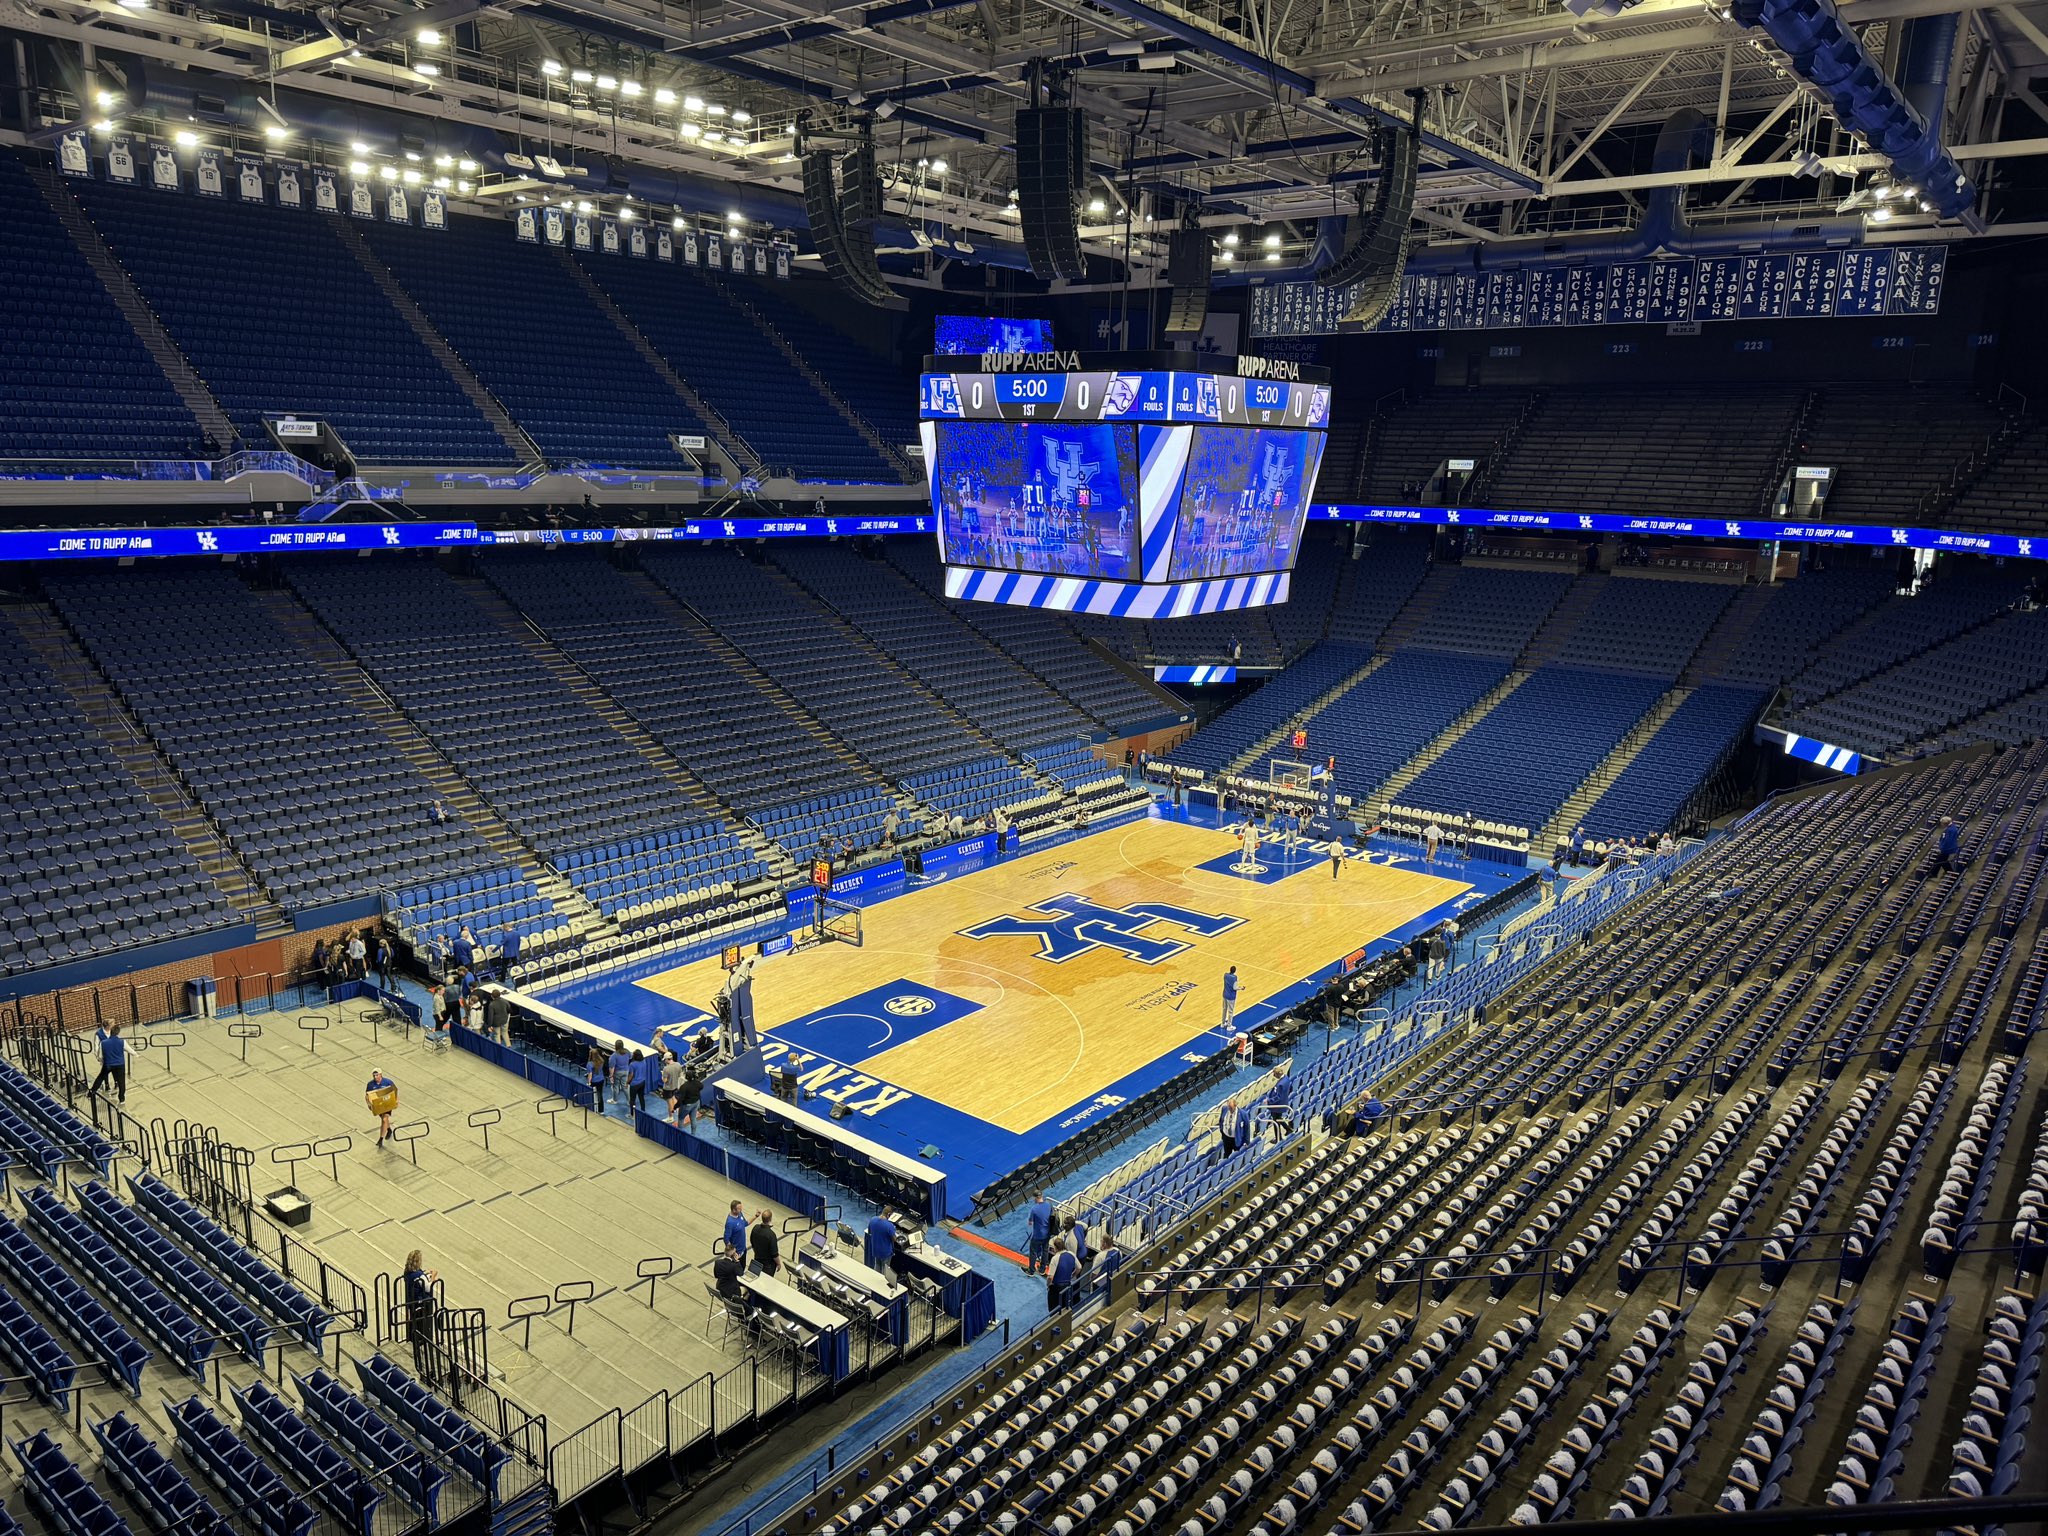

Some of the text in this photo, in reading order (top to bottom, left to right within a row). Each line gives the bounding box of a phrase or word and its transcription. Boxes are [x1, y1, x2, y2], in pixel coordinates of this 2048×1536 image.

[286, 184, 292, 192] 4
[314, 169, 336, 178] BEARD
[322, 189, 330, 197] 12
[1529, 272, 1542, 312] NCAA
[1569, 270, 1582, 312] NCAA
[1610, 267, 1624, 309] NCAA
[1650, 265, 1666, 308] NCAA
[1664, 268, 1678, 316] RUNNER UP
[1696, 262, 1712, 306] NCAA
[1712, 263, 1726, 316] CHAMPION
[1742, 259, 1758, 304] NCAA
[1759, 262, 1772, 312] FINAL FOUR
[1772, 270, 1786, 314] 2011
[1790, 256, 1808, 302] NCAA
[1806, 258, 1821, 311] CHAMPION
[1820, 268, 1836, 312] 2012
[1840, 254, 1859, 300] NCAA
[1858, 256, 1872, 310] RUNNER UP
[1871, 266, 1887, 312] 2014
[1892, 252, 1912, 298] NCAA
[1910, 253, 1925, 308] FINAL FOUR
[1925, 264, 1942, 310] 2015
[1252, 288, 1262, 324] NCAA
[1282, 285, 1294, 322] NCAA
[1294, 287, 1302, 330] CHAMPION
[1314, 286, 1324, 322] NCAA
[1401, 290, 1410, 328] 1958
[1416, 278, 1428, 316] NCAA
[1438, 290, 1448, 327] 1966
[1454, 276, 1466, 316] NCAA
[1475, 288, 1485, 326] 1975
[1490, 275, 1502, 315] NCAA
[1503, 276, 1513, 322] CHAMPION
[1513, 284, 1524, 322] 1978
[1542, 274, 1552, 320] FINAL FOUR
[1552, 283, 1564, 322] 1984
[1582, 272, 1592, 320] FINAL FOUR
[1594, 281, 1604, 322] 1993
[1624, 268, 1636, 318] CHAMPION
[1635, 278, 1647, 318] 1996
[1677, 276, 1690, 318] 1997
[1724, 273, 1738, 316] 1998
[1271, 297, 1279, 332] 1942
[1302, 296, 1312, 332] 1948
[1263, 352, 1314, 360] PARTNER OF
[1264, 344, 1318, 352] HEALTHCARE
[1612, 344, 1630, 353] 223
[1744, 341, 1764, 350] 223
[1882, 337, 1904, 347] 224
[1977, 334, 1993, 345] 224
[981, 350, 1082, 372] RUPP ARENA
[1238, 354, 1300, 381] RUPP ARENA
[972, 382, 983, 410] 0
[1012, 380, 1048, 397] 5:00
[1078, 381, 1090, 410] 0
[1150, 386, 1157, 400] 0
[1182, 388, 1189, 401] 0
[1228, 385, 1236, 414] 0
[1256, 386, 1278, 404] 5:00
[1294, 392, 1303, 418] 0
[1023, 404, 1036, 416] 1ST
[1143, 402, 1164, 412] FOULS
[1176, 403, 1194, 412] FOULS
[1262, 410, 1270, 422] 1ST
[1370, 510, 1385, 518] COME
[1386, 510, 1392, 518] TO
[1494, 514, 1510, 522] COME
[1511, 514, 1518, 522] TO
[1630, 520, 1676, 530] COME TO RUPP
[60, 538, 127, 550] COME TO RUPP
[270, 532, 326, 544] COME TO RUPP
[443, 529, 461, 540] COME
[462, 529, 472, 539] TO
[582, 532, 602, 540] 5:00
[1784, 527, 1834, 537] COME TO RUPP
[1938, 536, 1954, 544] COME
[1954, 536, 1962, 545] TO
[1294, 736, 1305, 746] 20
[958, 840, 984, 854] KENTUCKY
[814, 870, 828, 884] 20
[816, 860, 828, 871] 5:00
[832, 876, 864, 892] KENTUCKY
[767, 936, 788, 952] KENTUCKY
[954, 892, 1250, 965] UK
[1134, 982, 1198, 1011] RUPP ARENA
[1059, 1103, 1104, 1128] HealthCare
